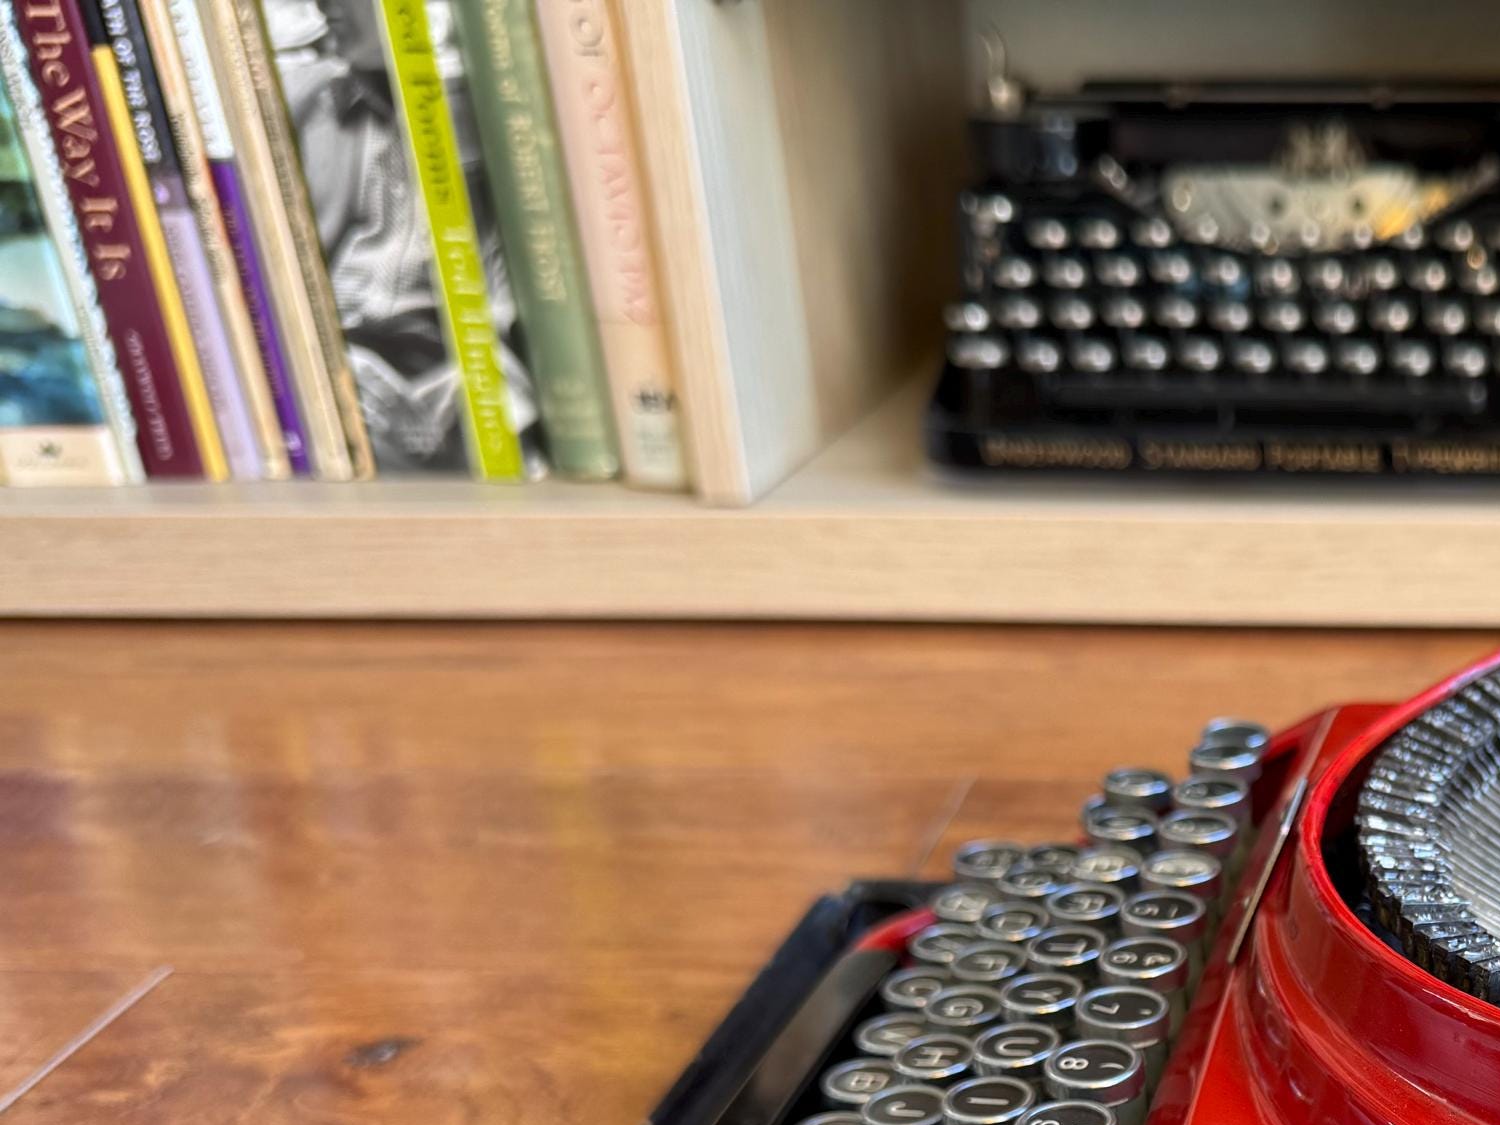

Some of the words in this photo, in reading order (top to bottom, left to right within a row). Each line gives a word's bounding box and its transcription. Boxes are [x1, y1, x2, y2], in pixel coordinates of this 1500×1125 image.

[25, 0, 72, 88] The
[53, 85, 99, 188] Way
[80, 197, 118, 233] It
[94, 245, 132, 280] Is
[913, 1045, 959, 1067] H
[995, 1036, 1040, 1057] U
[1059, 1056, 1089, 1071] 8
[886, 1101, 926, 1118] J
